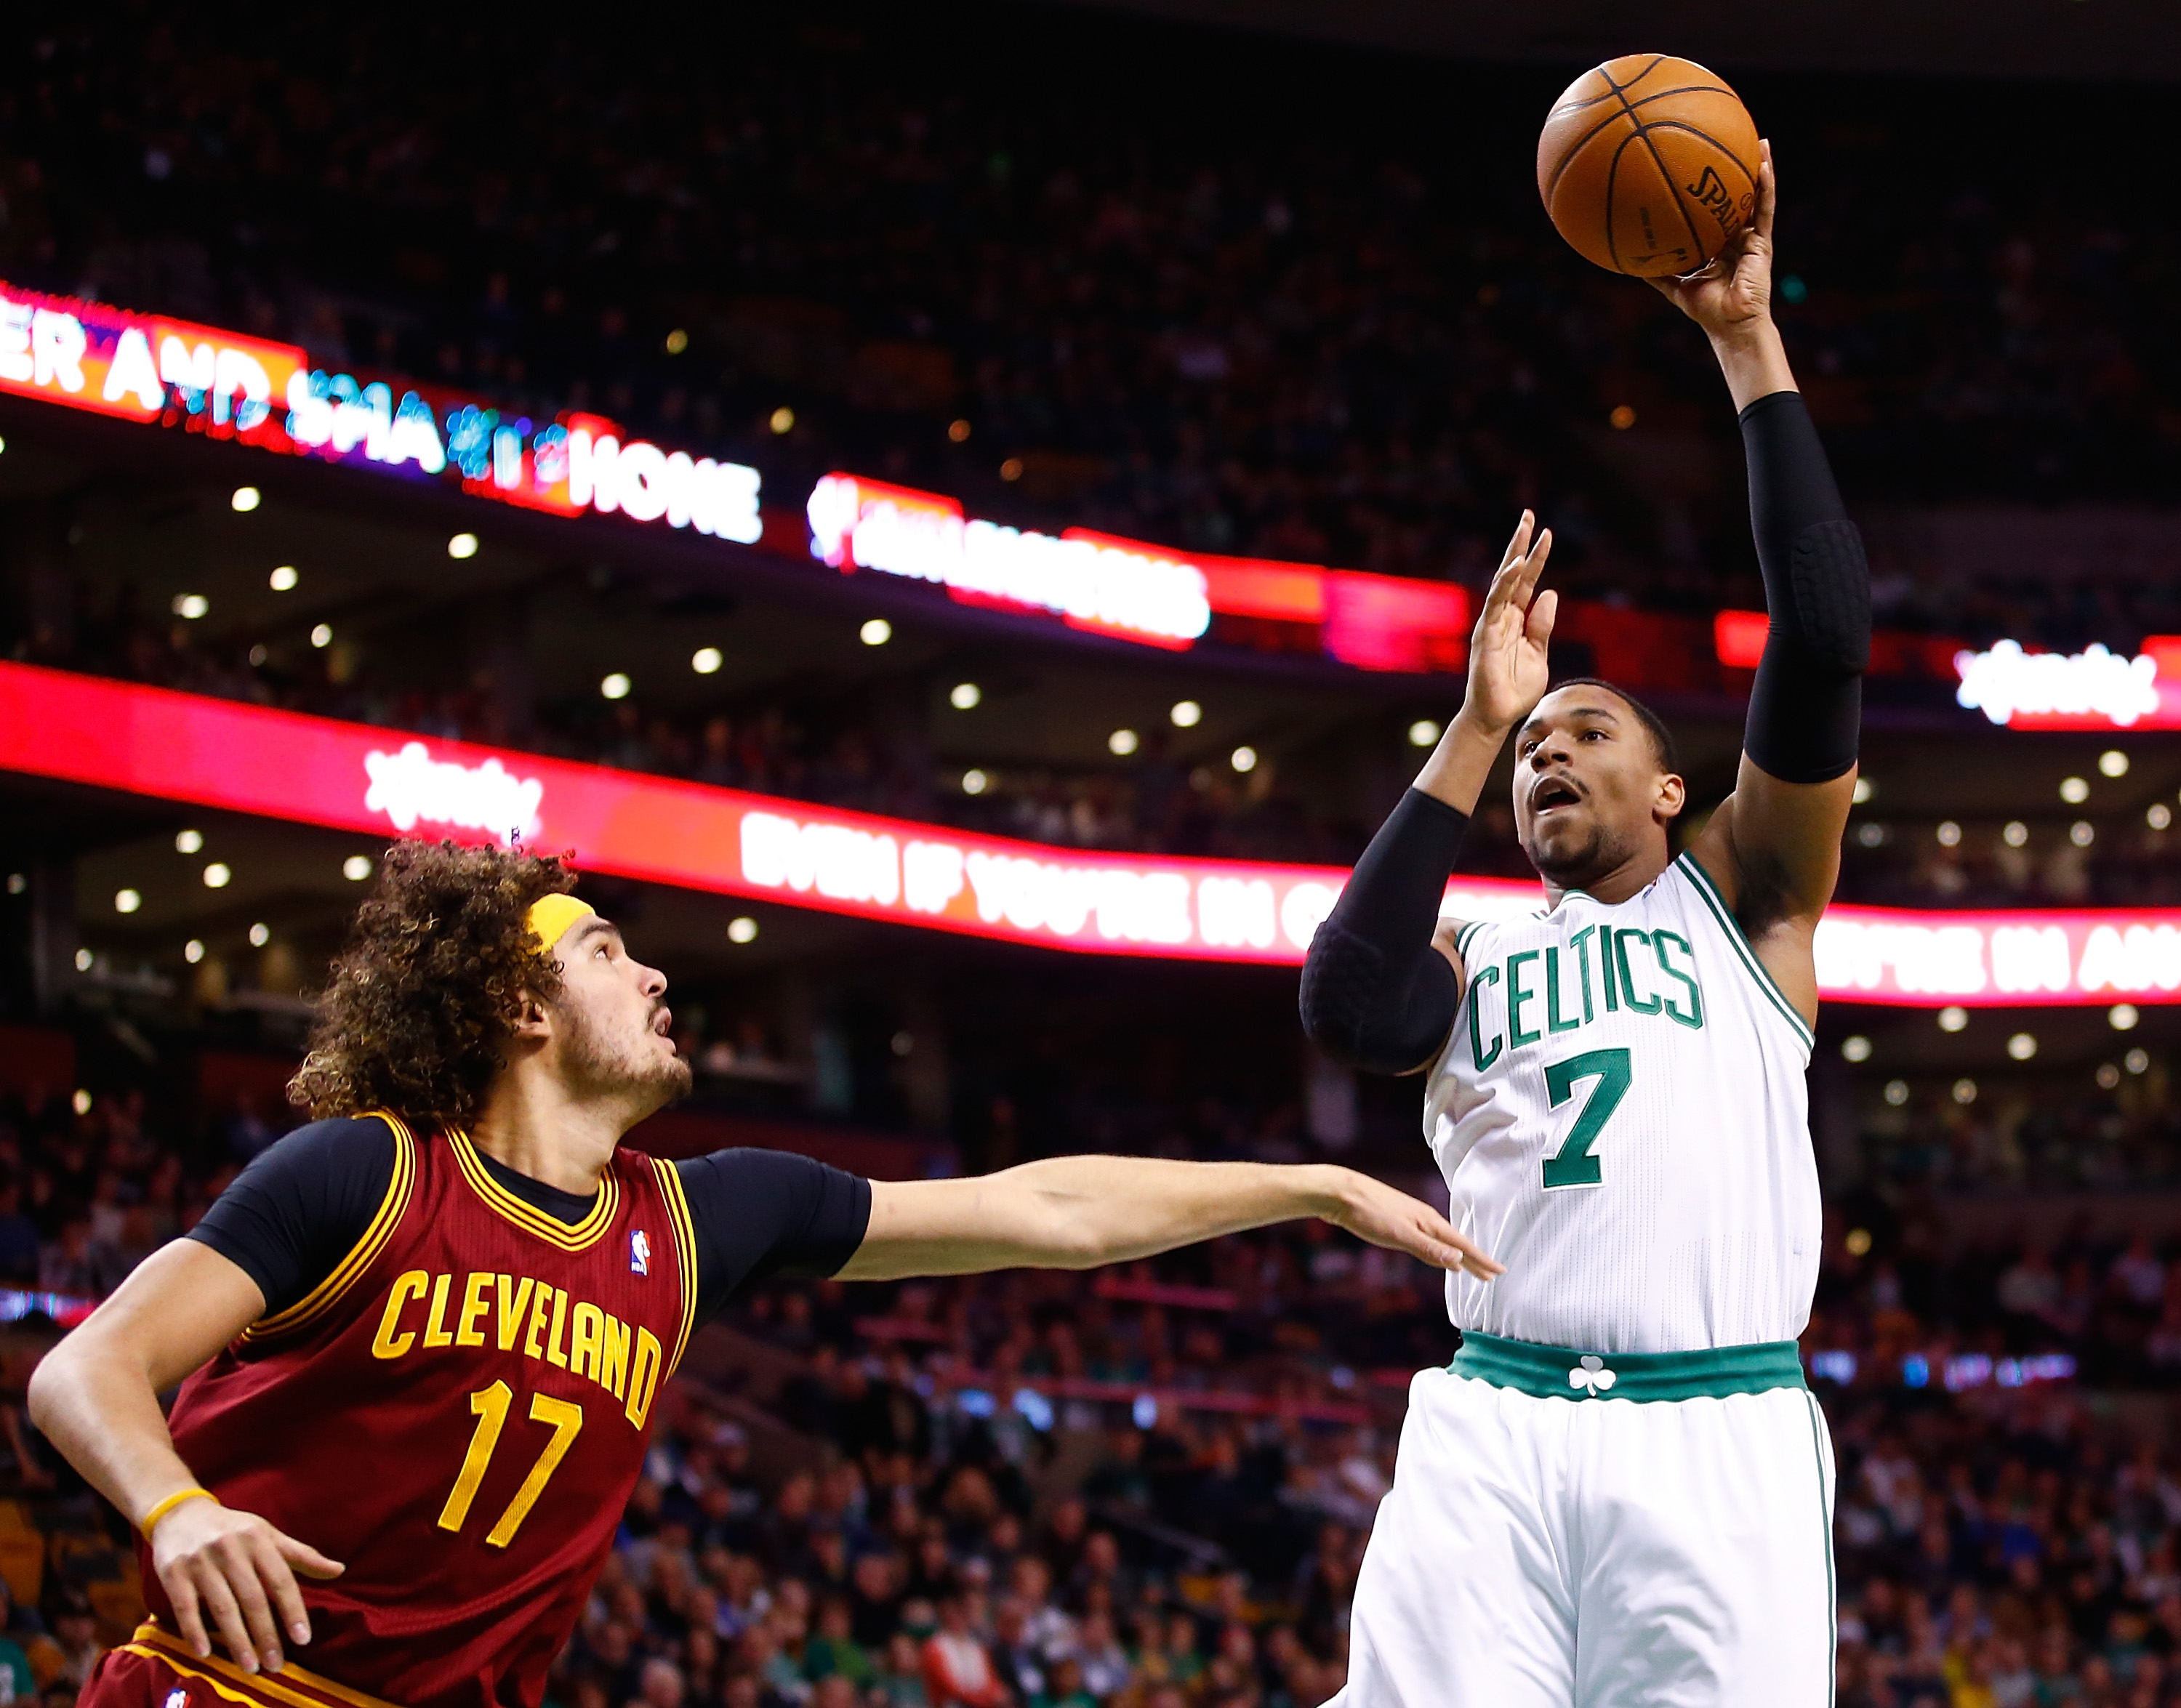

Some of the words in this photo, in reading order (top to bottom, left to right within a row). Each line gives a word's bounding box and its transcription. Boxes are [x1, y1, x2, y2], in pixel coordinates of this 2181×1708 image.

[1468, 923, 1703, 1072] CELTICS
[1541, 1047, 1633, 1190] 7
[371, 1269, 662, 1432] CLEVELAND
[437, 1378, 583, 1549] 17
